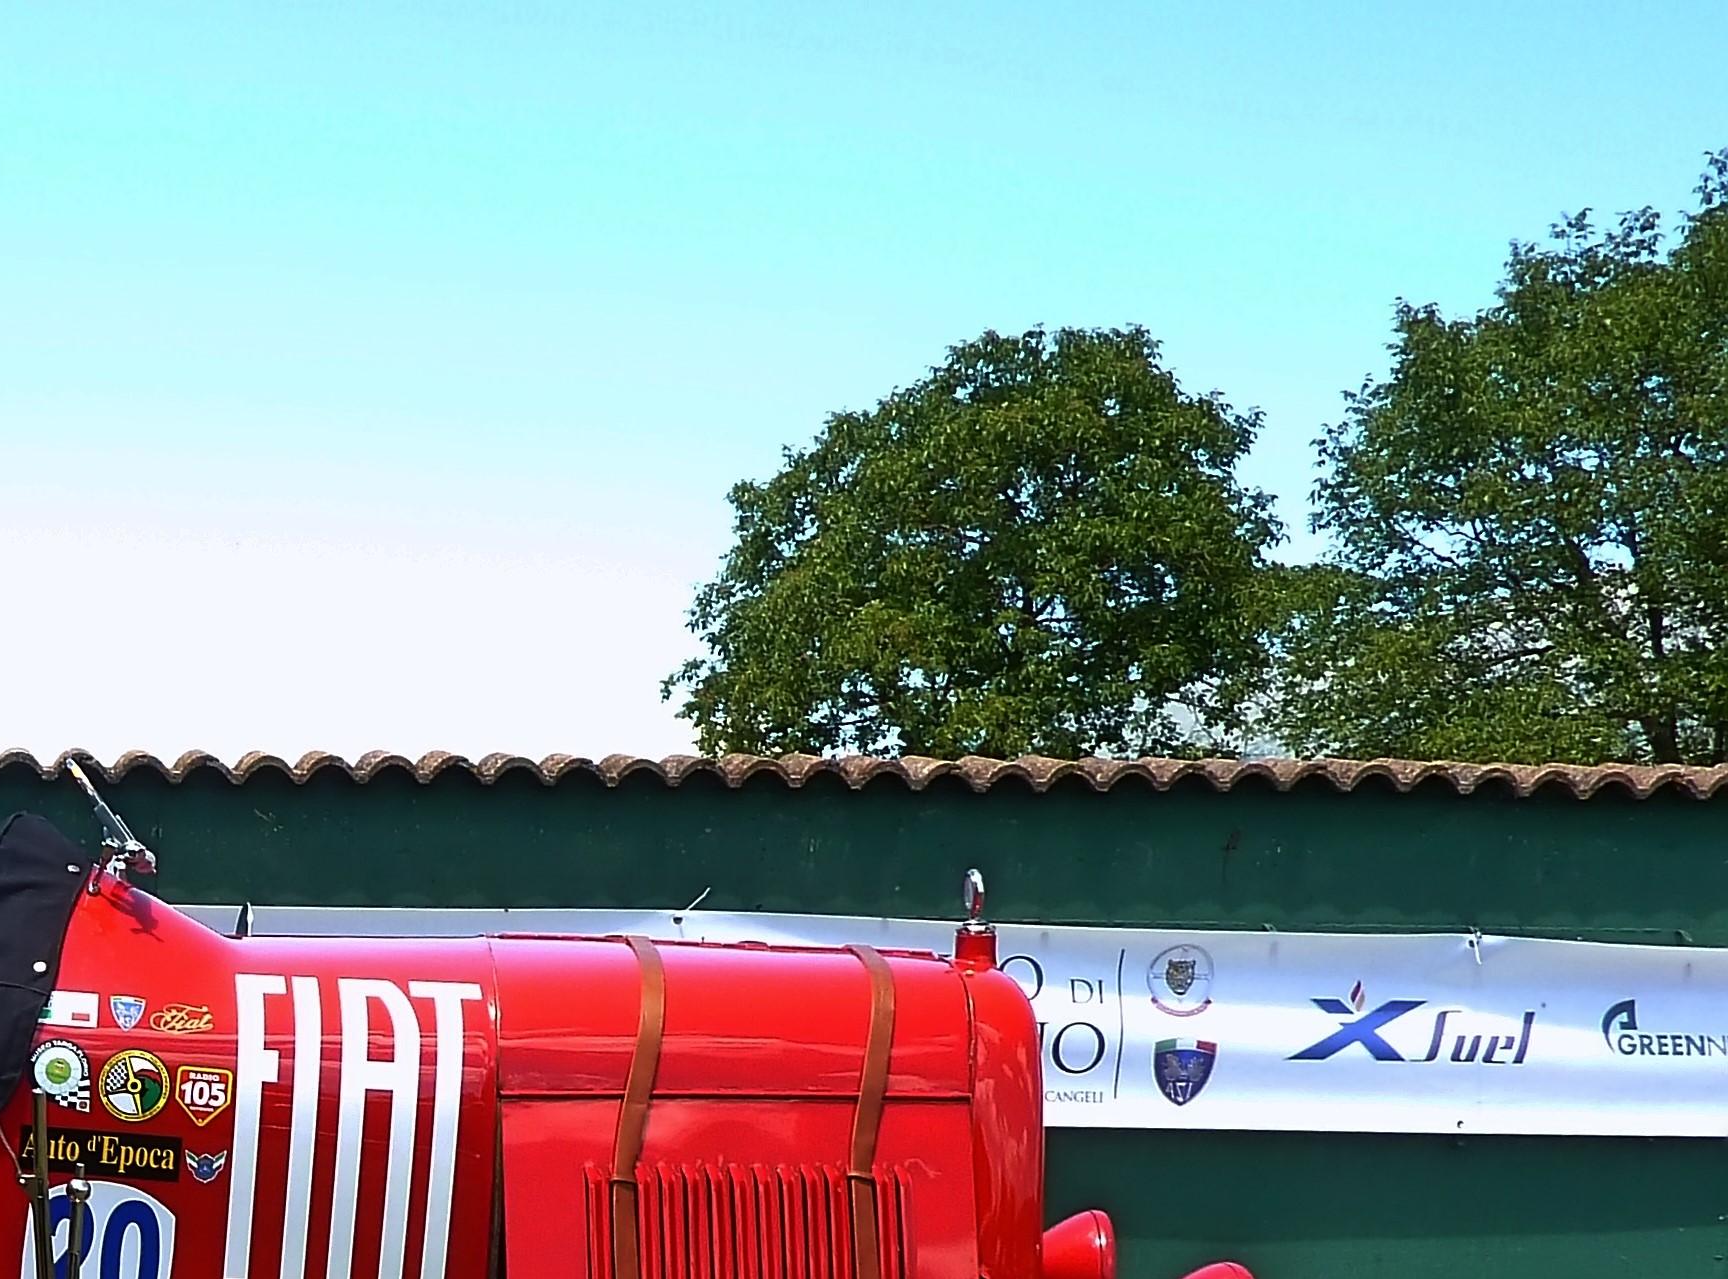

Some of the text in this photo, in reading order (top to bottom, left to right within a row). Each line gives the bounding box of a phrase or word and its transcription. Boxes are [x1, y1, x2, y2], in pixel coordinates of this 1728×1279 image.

[1070, 978, 1104, 1004] DI
[150, 1003, 214, 1035] Fiat
[1617, 1033, 1728, 1057] GREENN
[188, 1071, 221, 1082] RADIO
[180, 1080, 227, 1107] 105
[87, 1134, 176, 1174] d'Epoca
